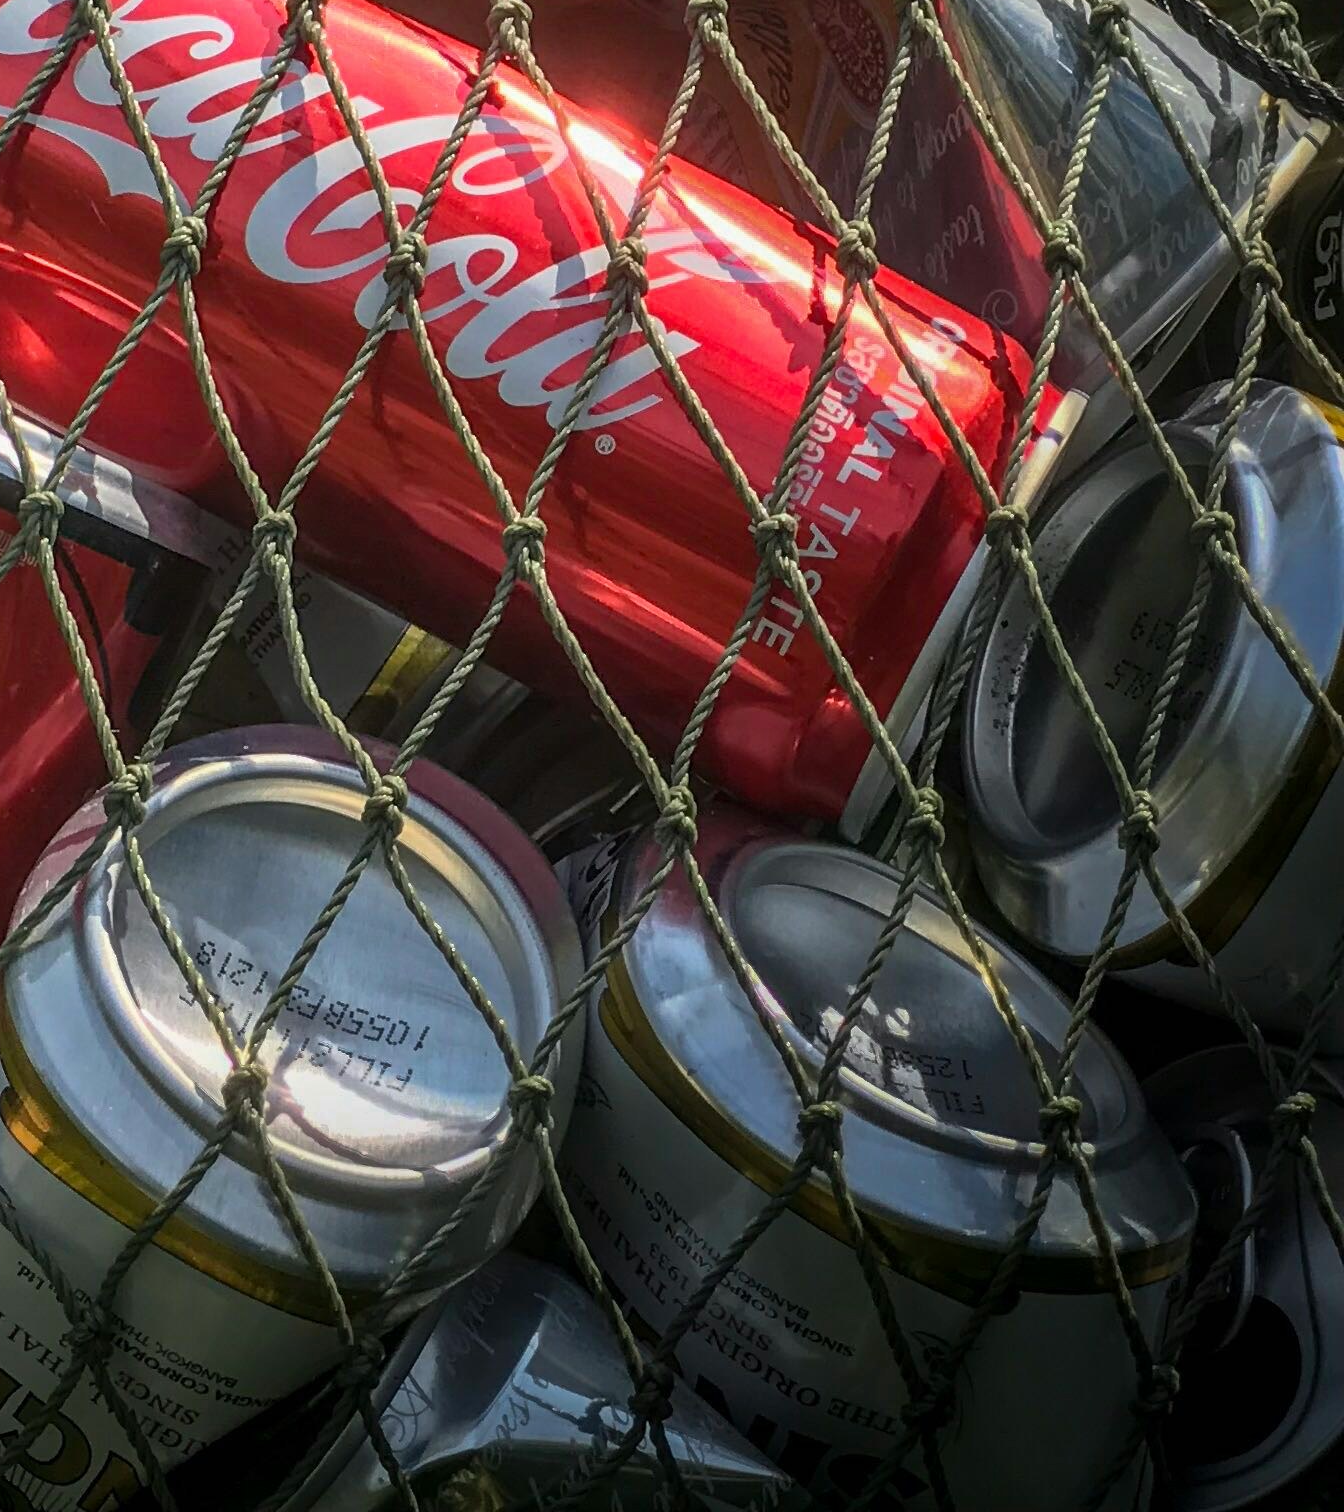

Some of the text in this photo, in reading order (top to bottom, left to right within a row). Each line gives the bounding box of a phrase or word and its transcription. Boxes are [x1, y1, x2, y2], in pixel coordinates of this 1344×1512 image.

[752, 504, 862, 658] TASTE
[9, 1258, 48, 1292] Ltd.
[614, 1229, 683, 1308] THAI
[648, 1222, 791, 1322] CORPOATION
[716, 1259, 813, 1321] BANGKOK
[68, 1285, 154, 1349] THAILND
[692, 1291, 825, 1406] ORIGINA
[696, 1295, 778, 1353] SINC
[103, 1321, 214, 1403] CORPORATI
[111, 1363, 201, 1433] SINCE
[823, 1386, 903, 1446] THE
